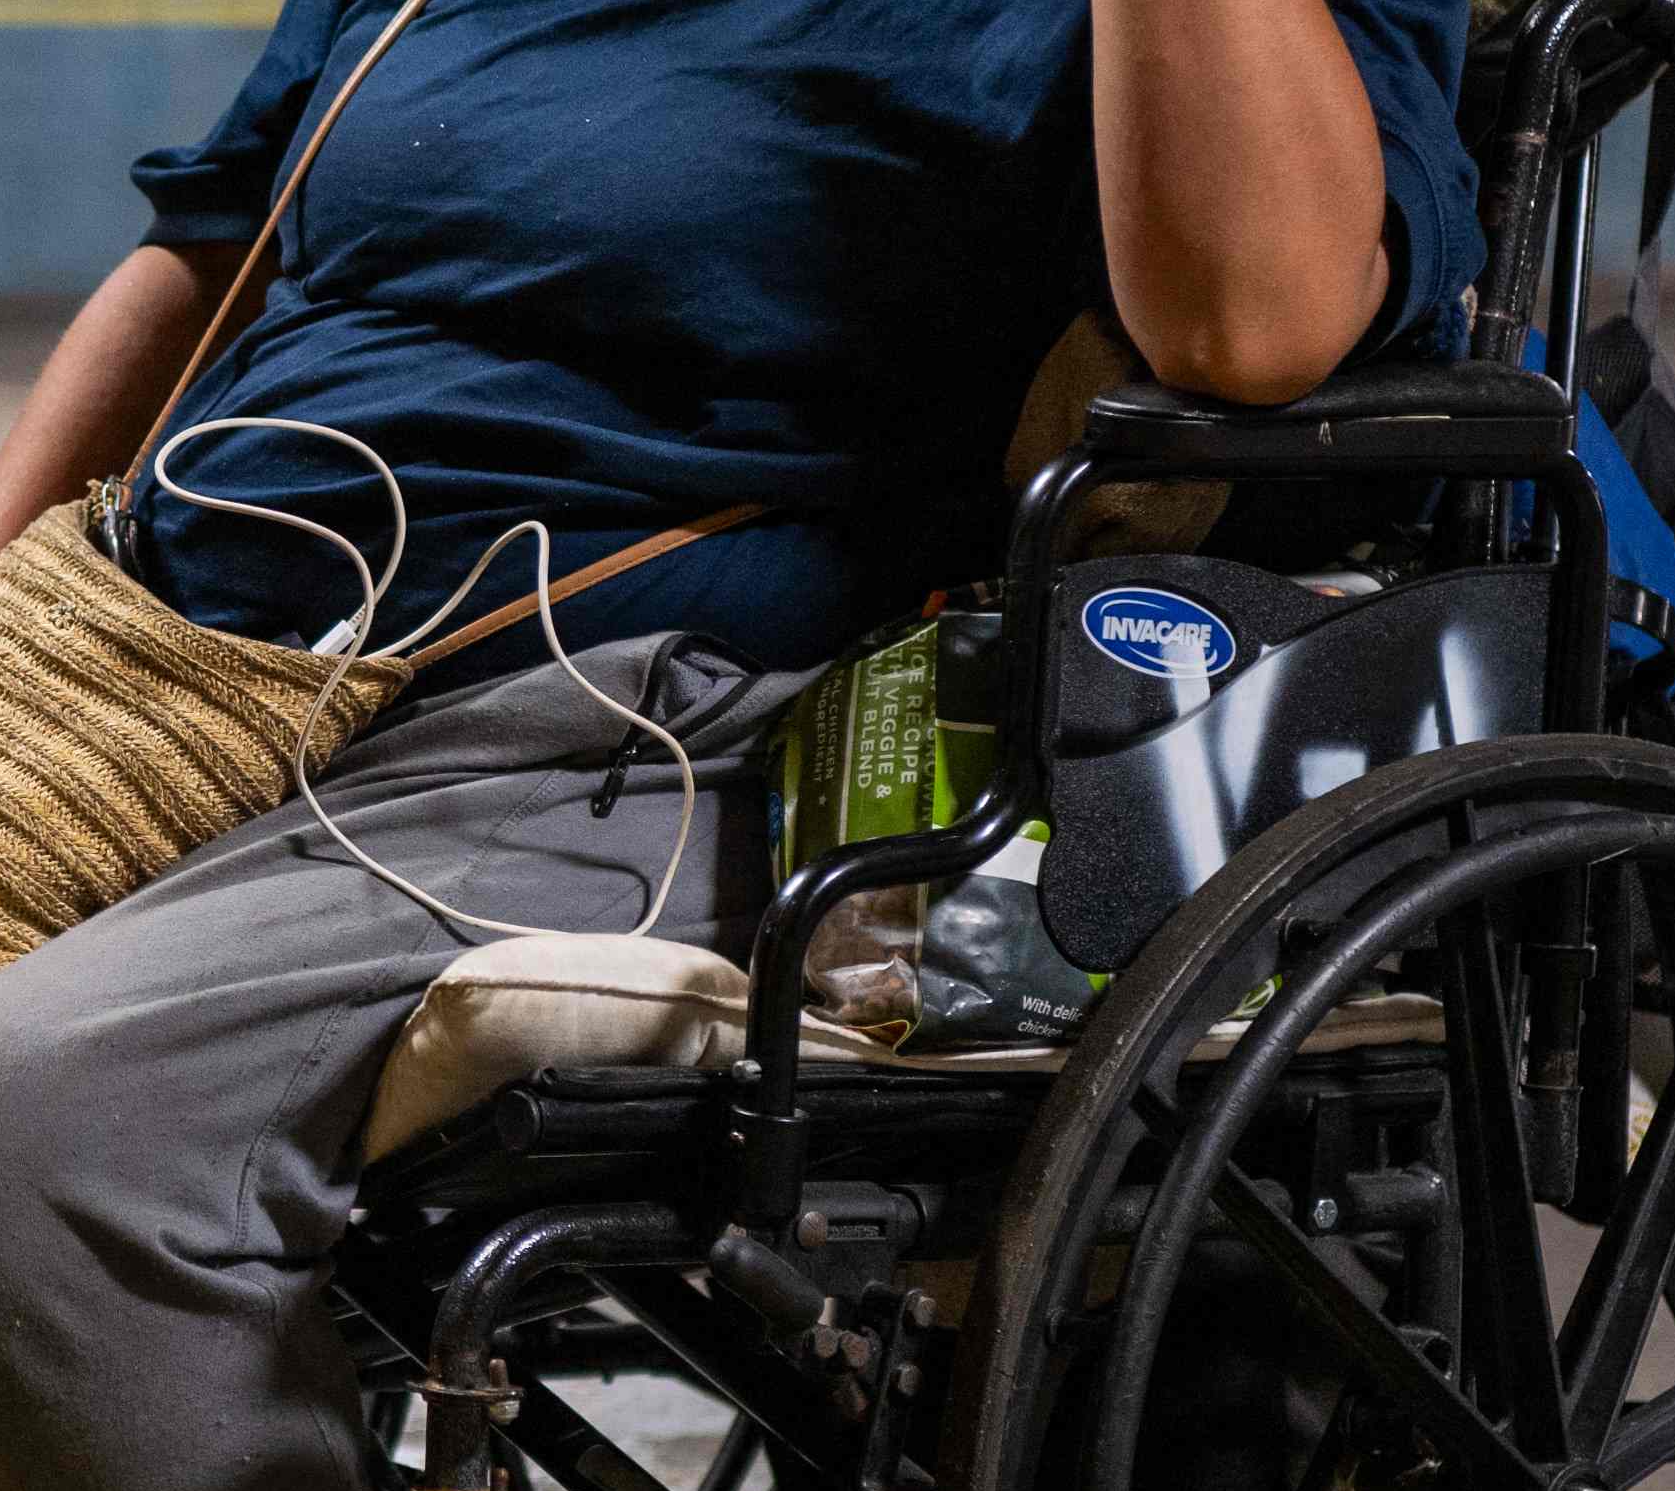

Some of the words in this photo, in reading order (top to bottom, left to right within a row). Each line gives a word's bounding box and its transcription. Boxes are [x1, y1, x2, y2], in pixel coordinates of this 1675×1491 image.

[1101, 615, 1212, 648] INVACARE
[825, 703, 840, 780] CHICKEN
[857, 709, 878, 789] BLEND
[877, 686, 901, 776] VEGGIE
[900, 694, 923, 784] RECIPE
[876, 784, 892, 799] &
[1022, 995, 1050, 1016] With
[1052, 1004, 1083, 1023] delic
